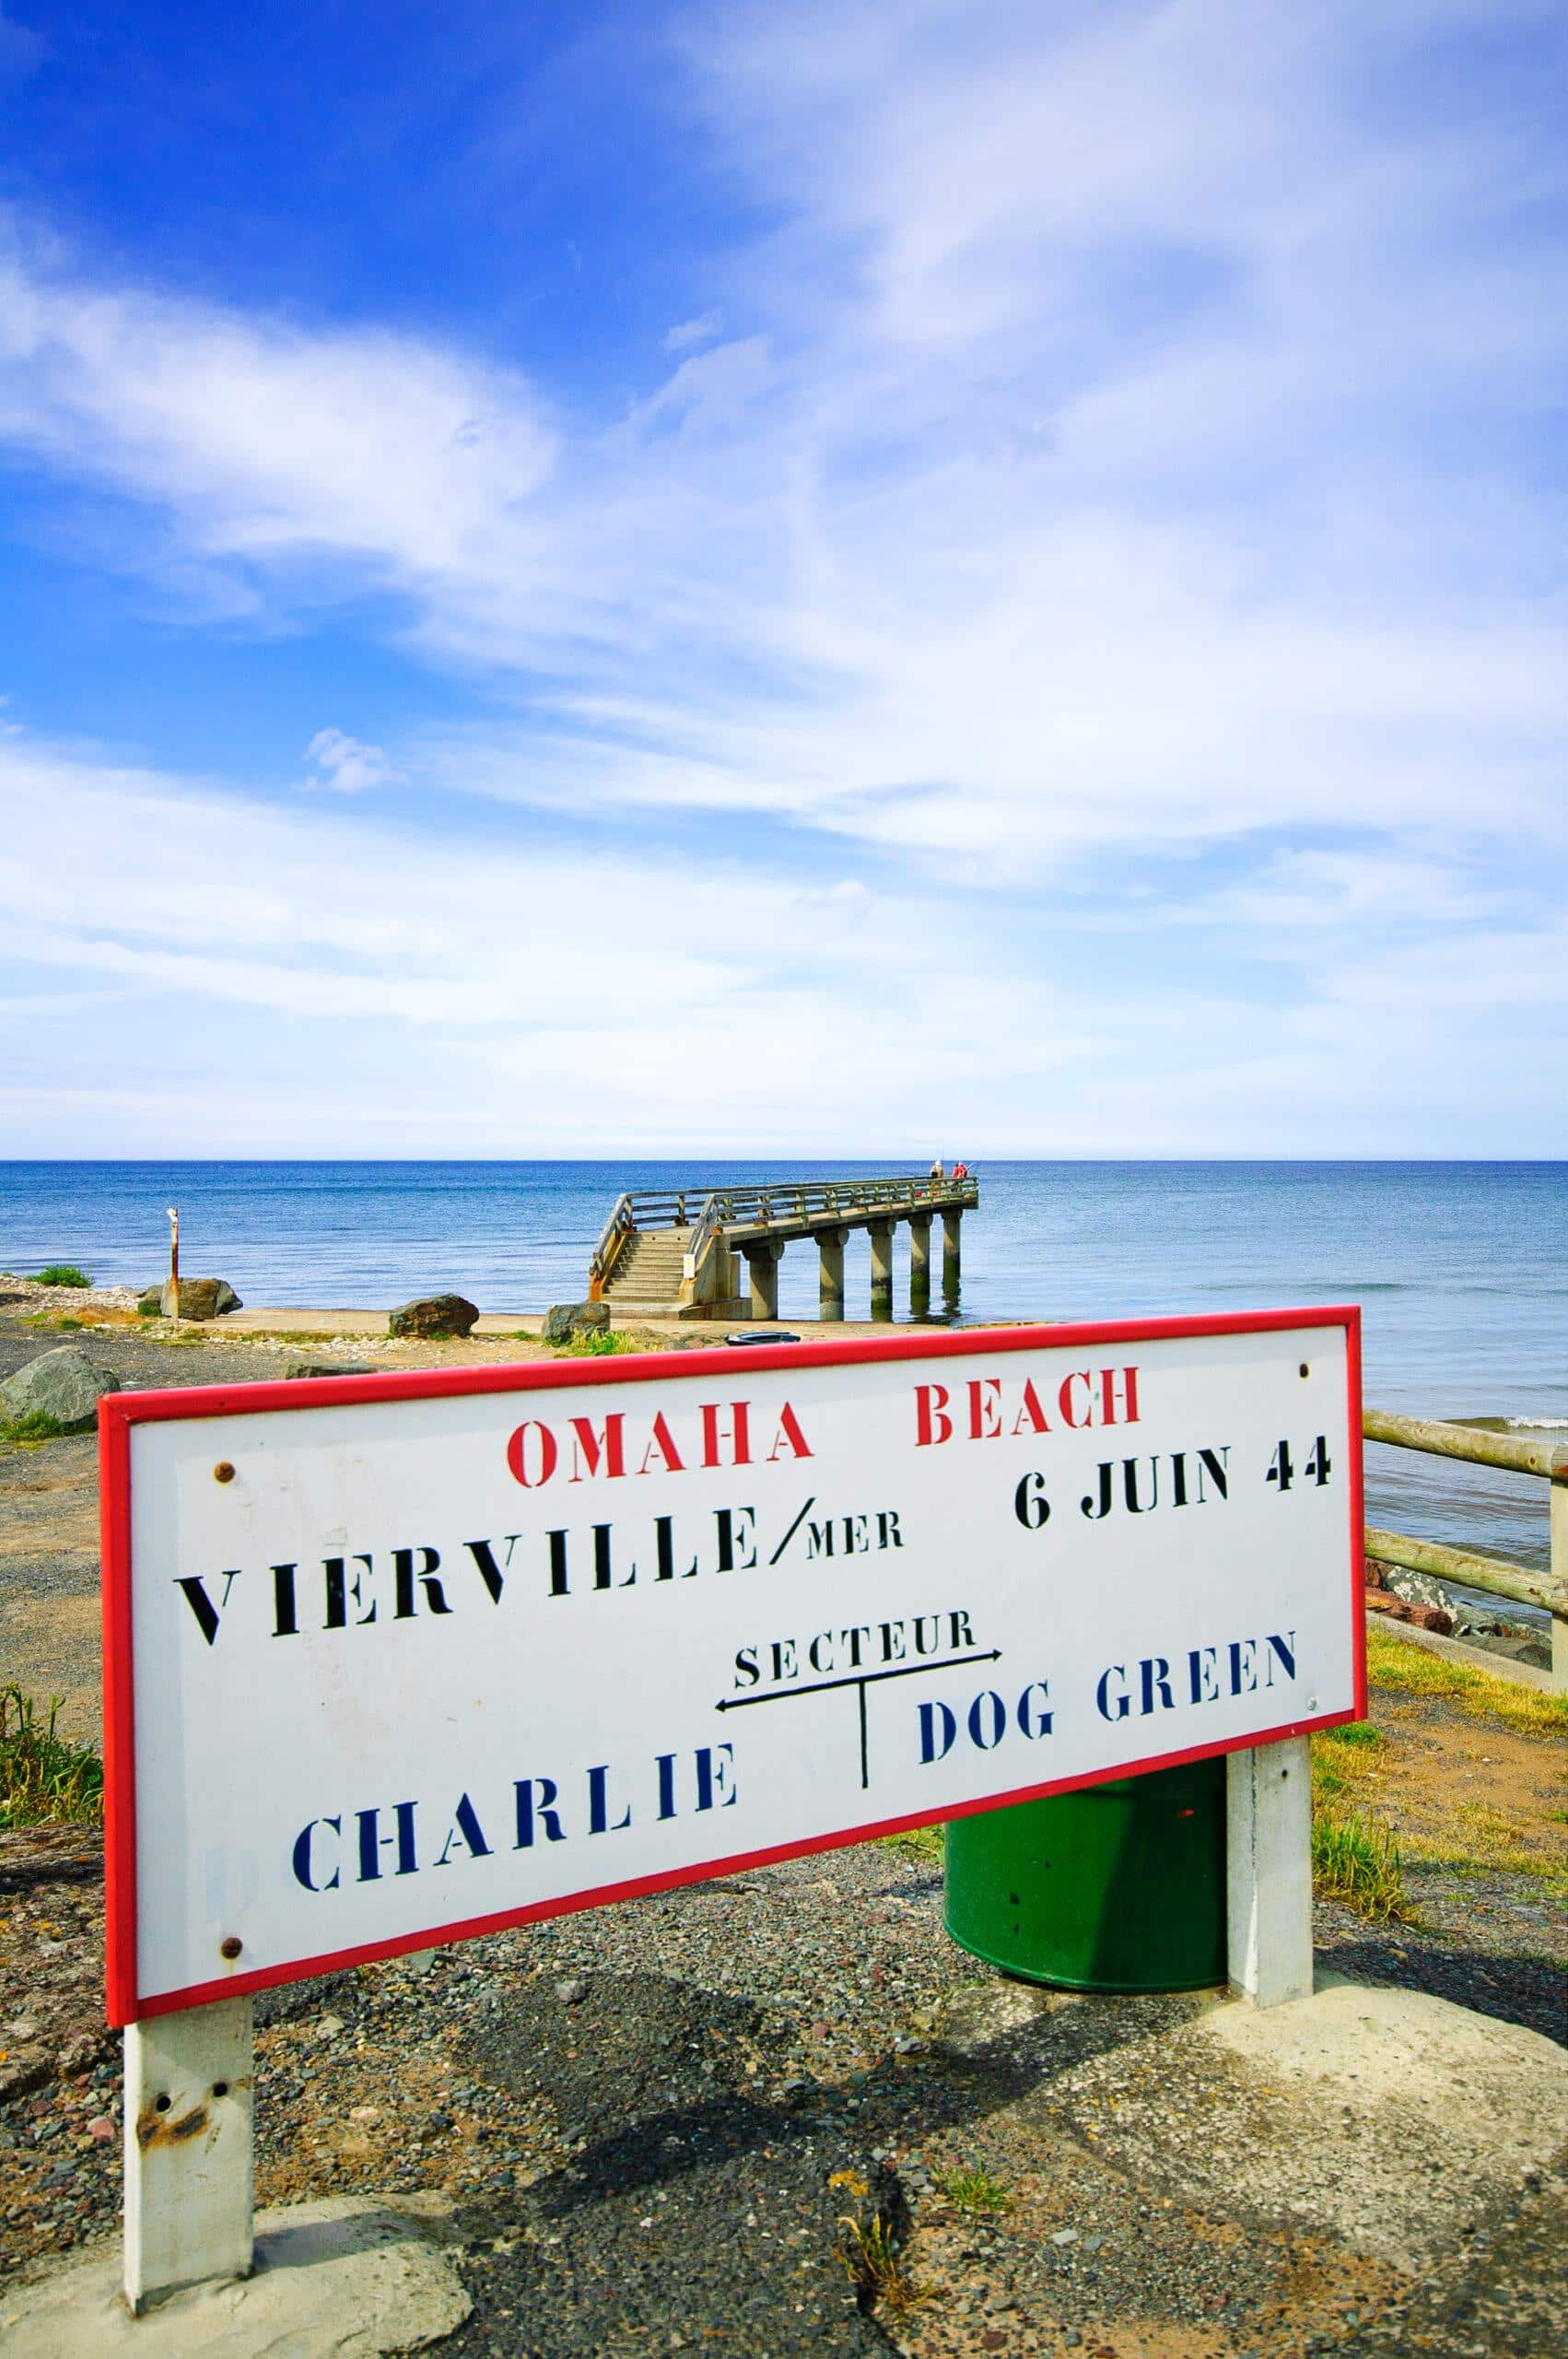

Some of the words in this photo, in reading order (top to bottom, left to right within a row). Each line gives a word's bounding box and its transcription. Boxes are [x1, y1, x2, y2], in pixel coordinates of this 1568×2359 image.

[507, 1401, 813, 1487] OMAHA
[914, 1367, 1140, 1447] BEACH
[1015, 1473, 1051, 1530] 6
[1080, 1446, 1232, 1520] JUIN
[1266, 1436, 1331, 1492] 44
[736, 1611, 977, 1687] SECTEUR
[918, 1681, 1055, 1766] DOG
[1096, 1631, 1296, 1722] GREEN
[292, 1743, 737, 1893] CHARLIE
